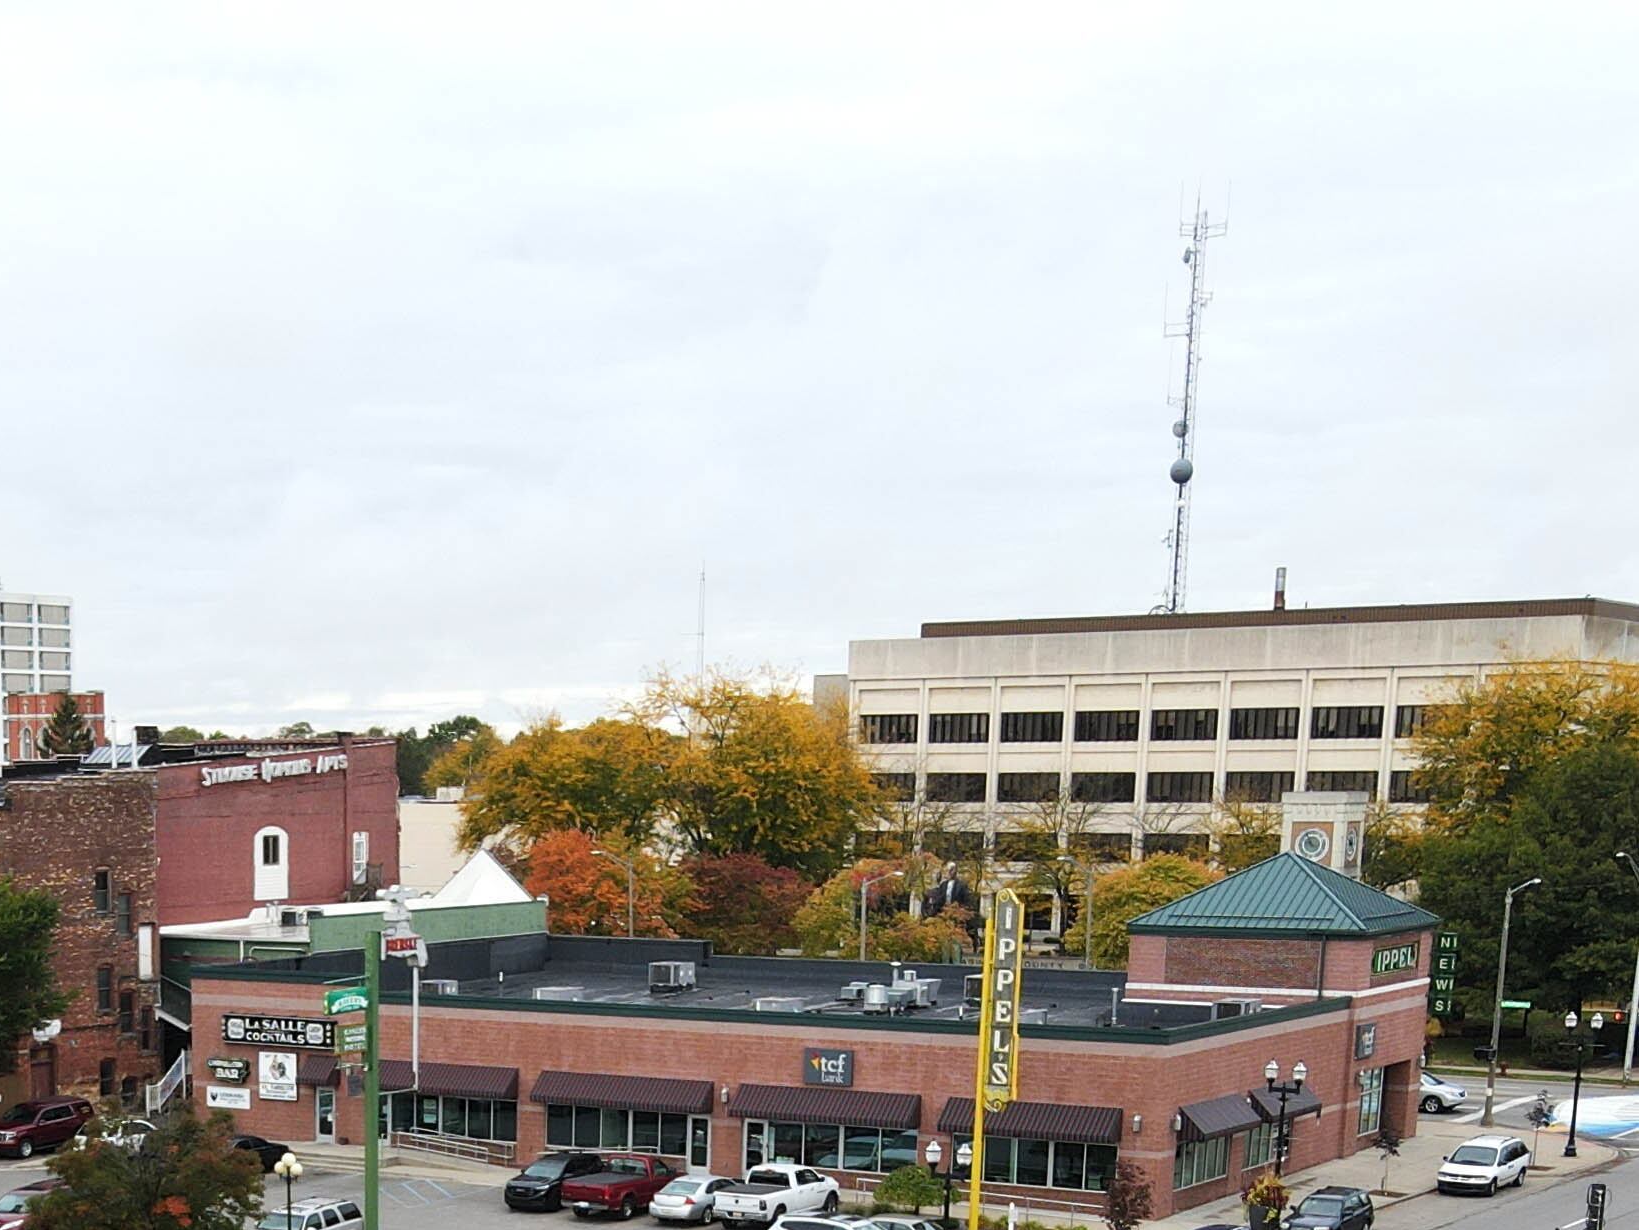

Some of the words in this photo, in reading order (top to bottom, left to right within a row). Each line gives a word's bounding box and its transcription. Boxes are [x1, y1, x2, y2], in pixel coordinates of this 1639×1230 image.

[1435, 937, 1451, 1012] NEWS
[246, 1031, 305, 1044] COCKTAILS
[820, 1054, 846, 1072] tcf
[215, 1067, 239, 1079] BAR
[821, 1072, 844, 1084] bank
